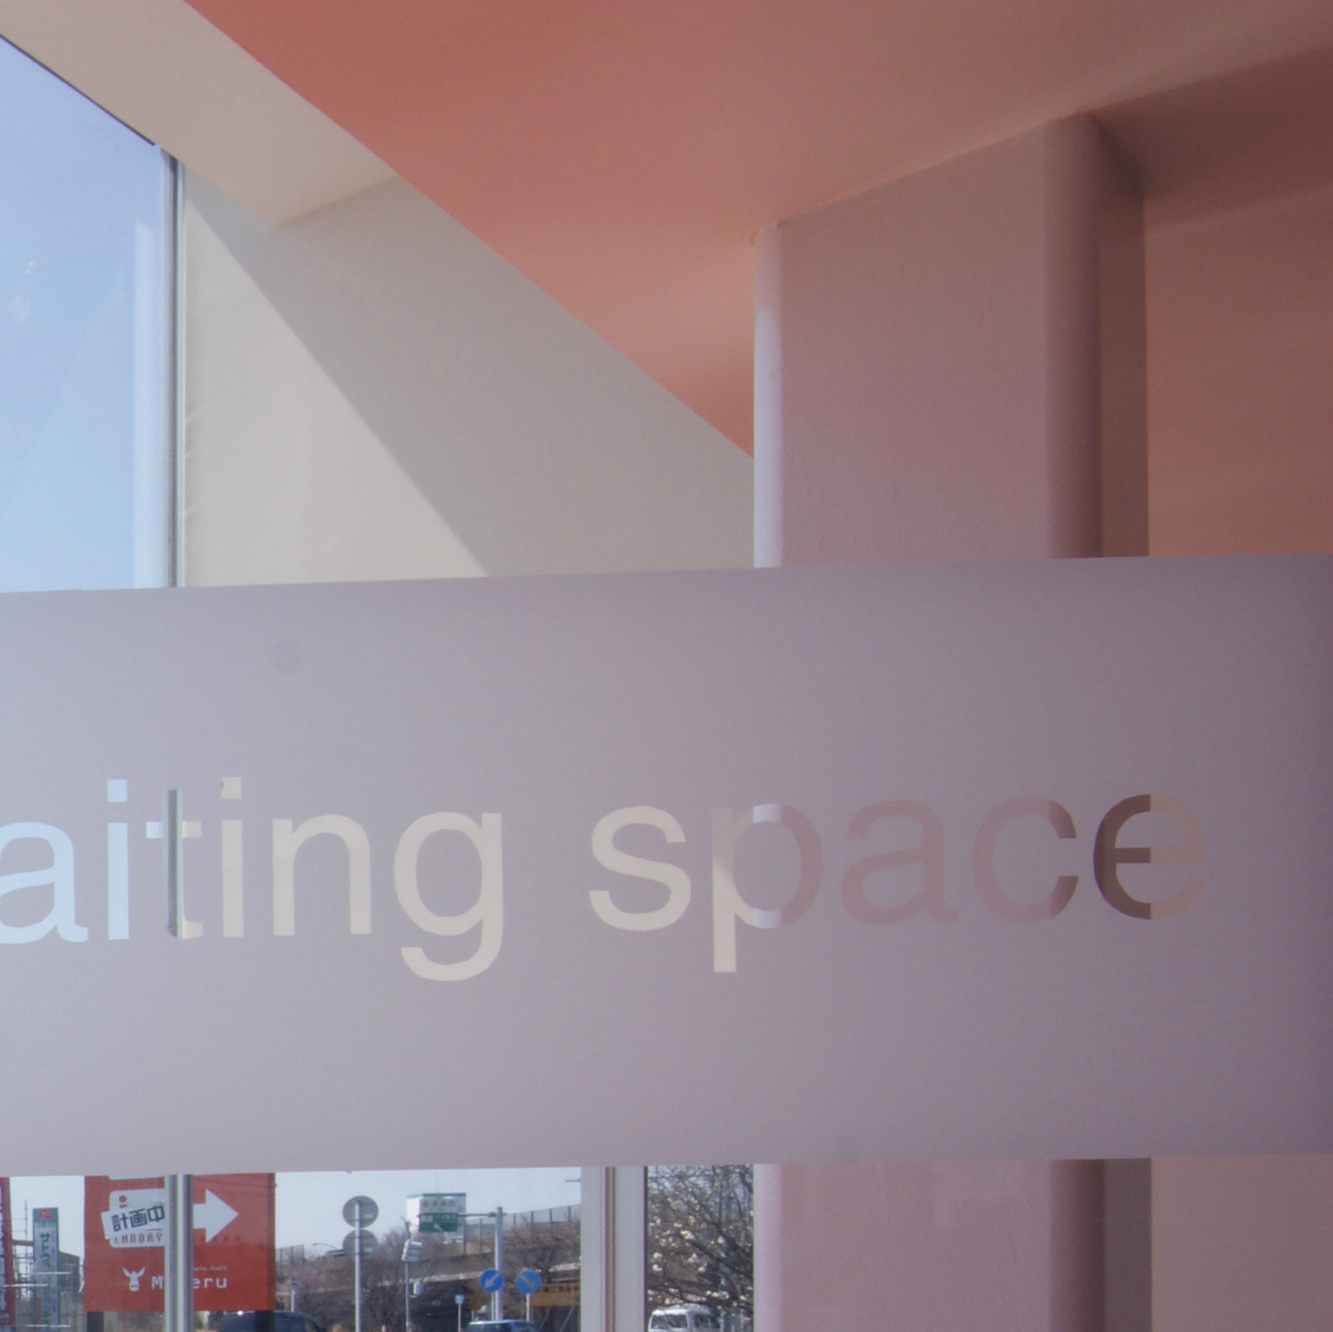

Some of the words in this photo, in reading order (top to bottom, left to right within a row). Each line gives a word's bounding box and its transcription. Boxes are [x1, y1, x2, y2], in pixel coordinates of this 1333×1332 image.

[589, 793, 1207, 973] space
[111, 1204, 165, 1232] 計画中
[151, 1276, 228, 1289] Meru
